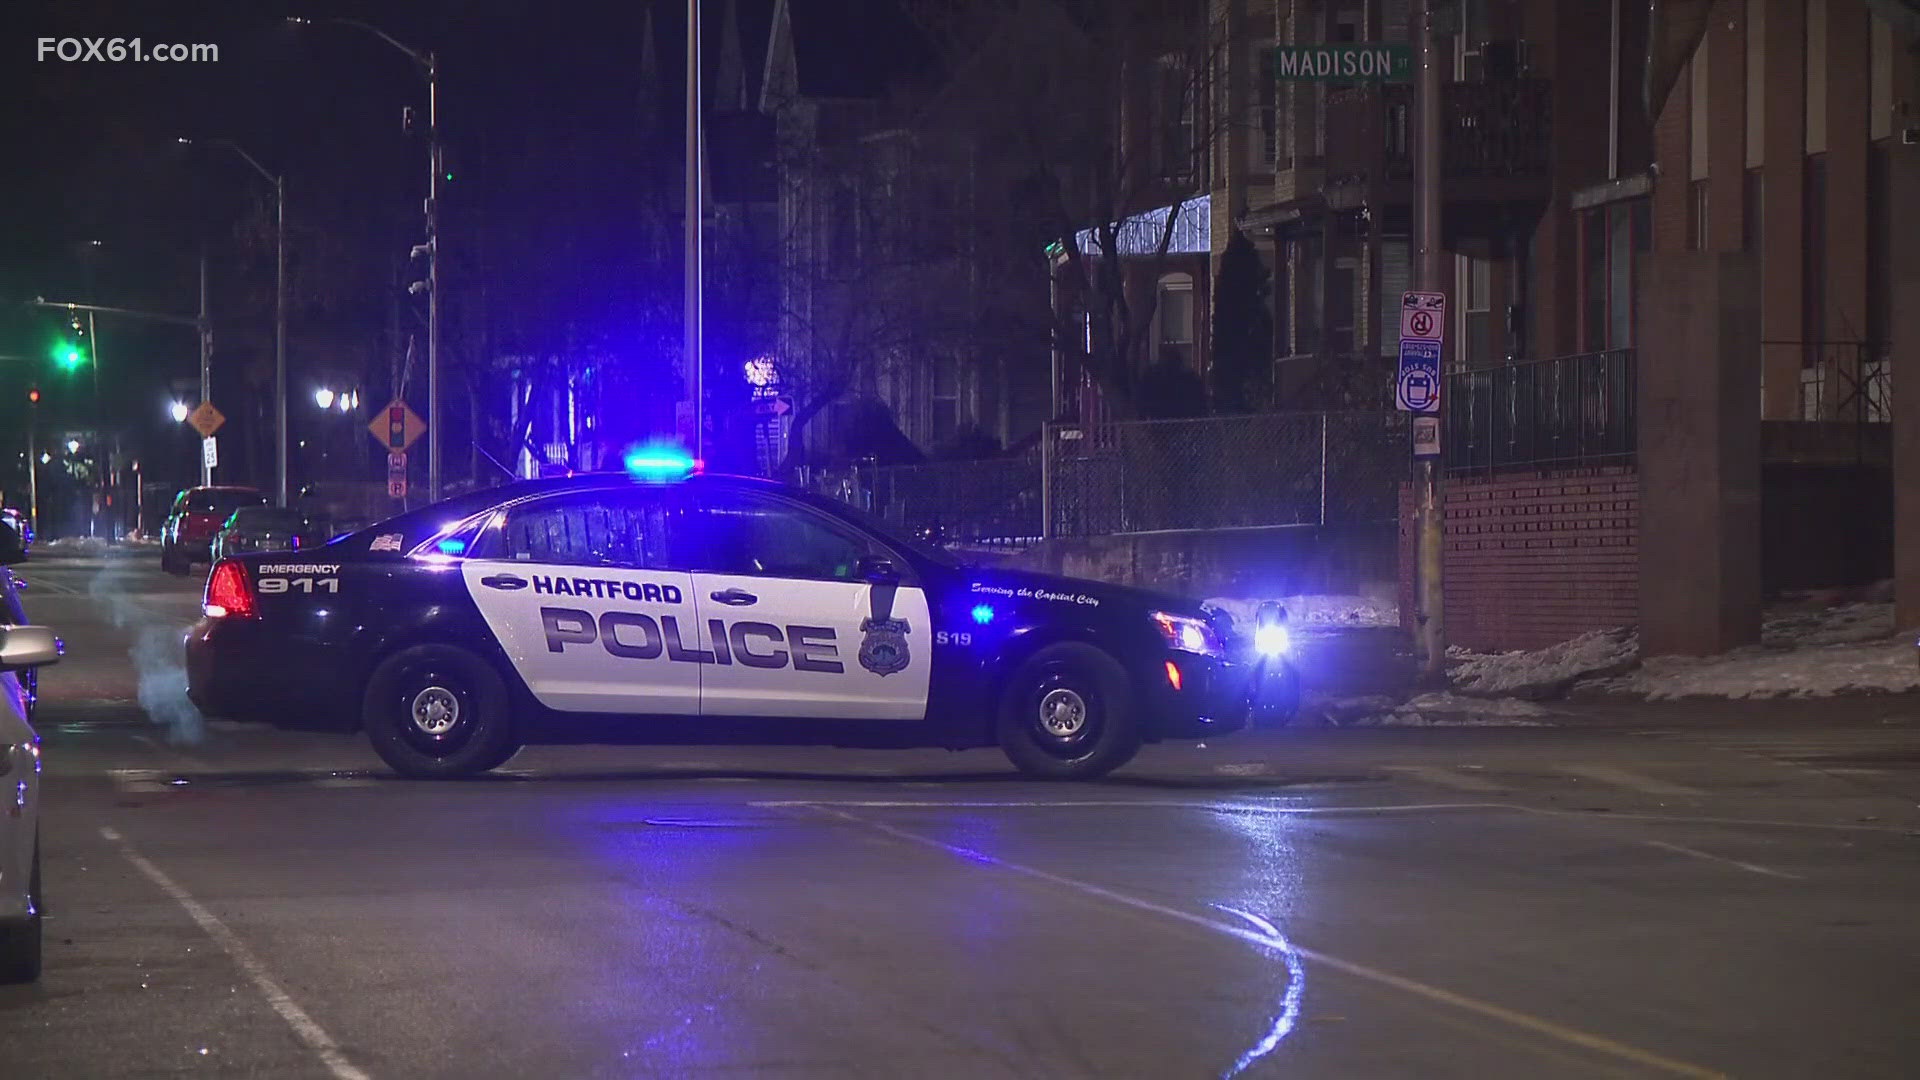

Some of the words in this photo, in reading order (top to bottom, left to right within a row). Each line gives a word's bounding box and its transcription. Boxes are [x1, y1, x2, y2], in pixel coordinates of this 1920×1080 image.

[1280, 50, 1391, 76] MADISON
[1401, 363, 1419, 377] STOP
[1422, 364, 1436, 377] BUS
[258, 564, 340, 574] EMERGENCY
[258, 578, 339, 593] 911
[532, 575, 683, 604] HARTFORD
[971, 582, 1014, 598] Serving
[1017, 588, 1032, 597] the
[1034, 589, 1075, 602] Capital
[1076, 594, 1099, 607] City
[540, 606, 845, 674] POLICE
[936, 631, 972, 646] S19
